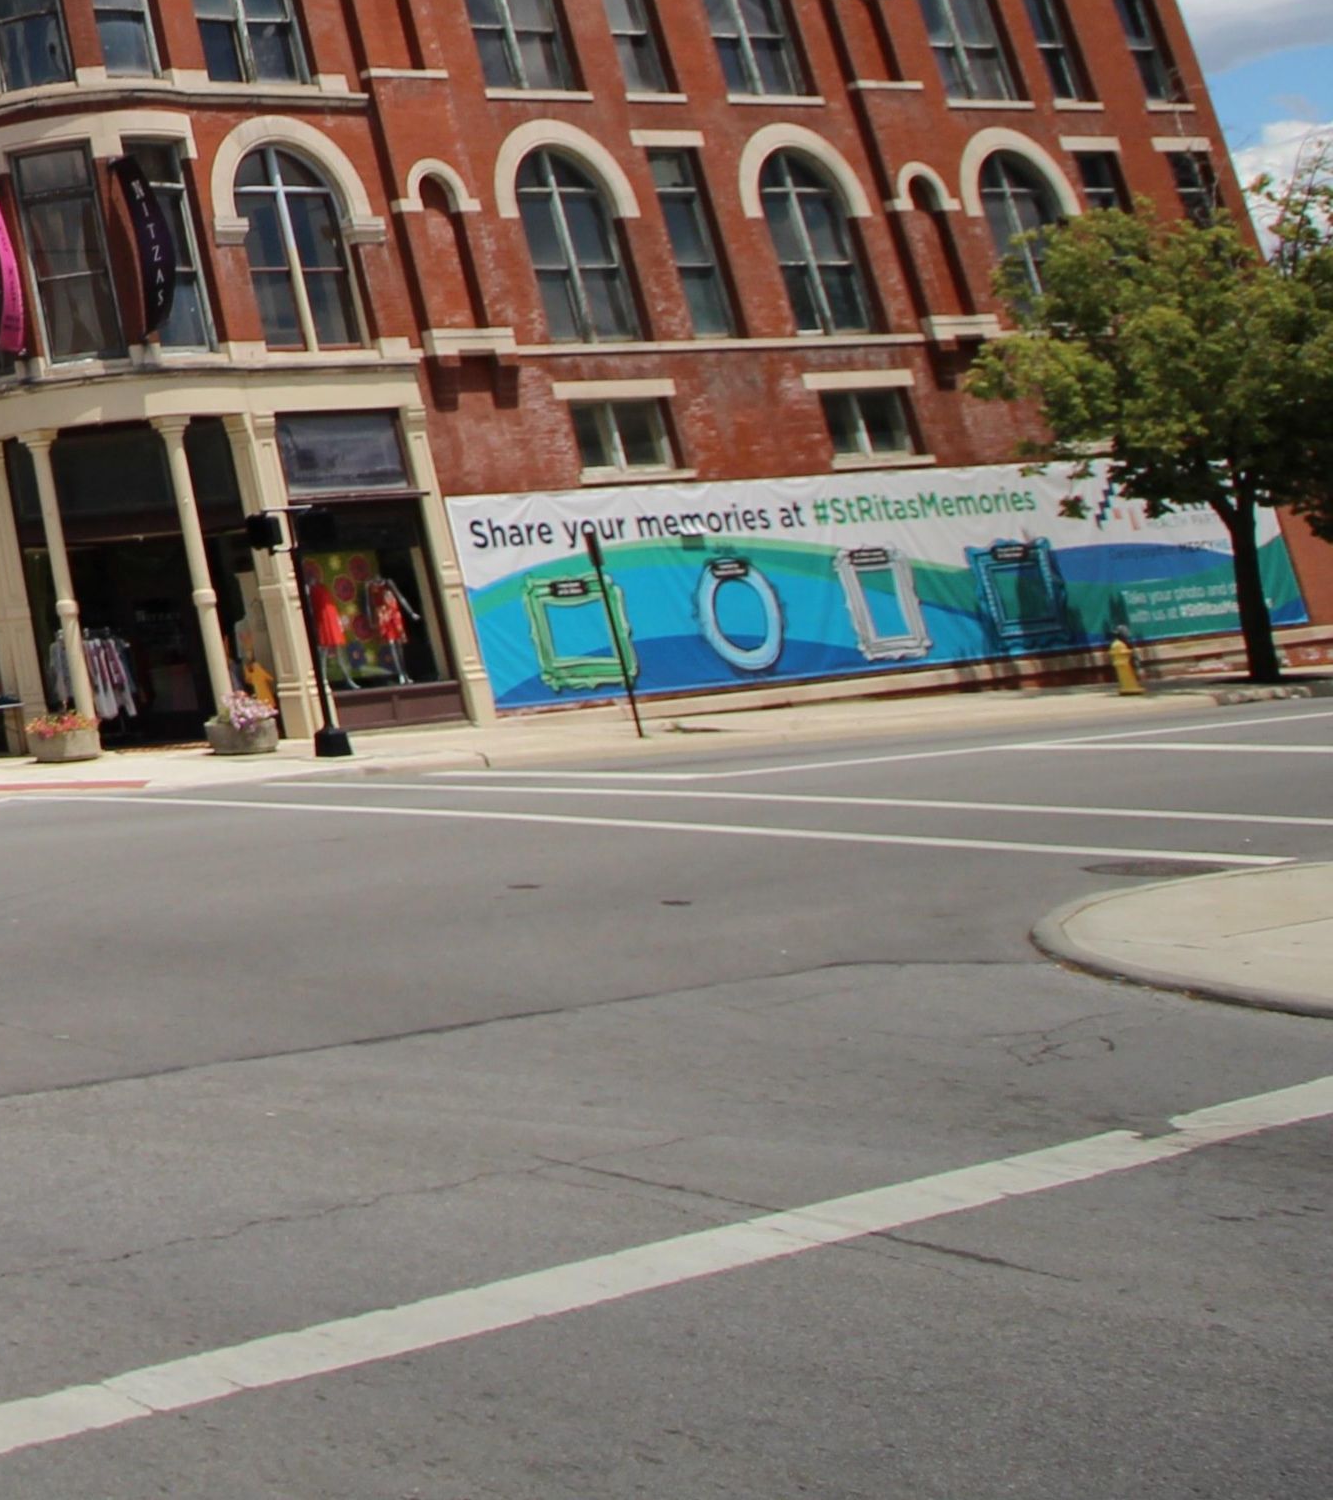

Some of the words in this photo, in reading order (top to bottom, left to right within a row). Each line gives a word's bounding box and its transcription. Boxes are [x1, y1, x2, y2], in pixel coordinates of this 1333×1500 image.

[131, 179, 165, 306] NITZAS
[469, 518, 553, 550] Share
[562, 516, 625, 549] your
[635, 503, 772, 538] memories
[778, 501, 806, 529] at
[812, 486, 1037, 526] #StRitasMemories
